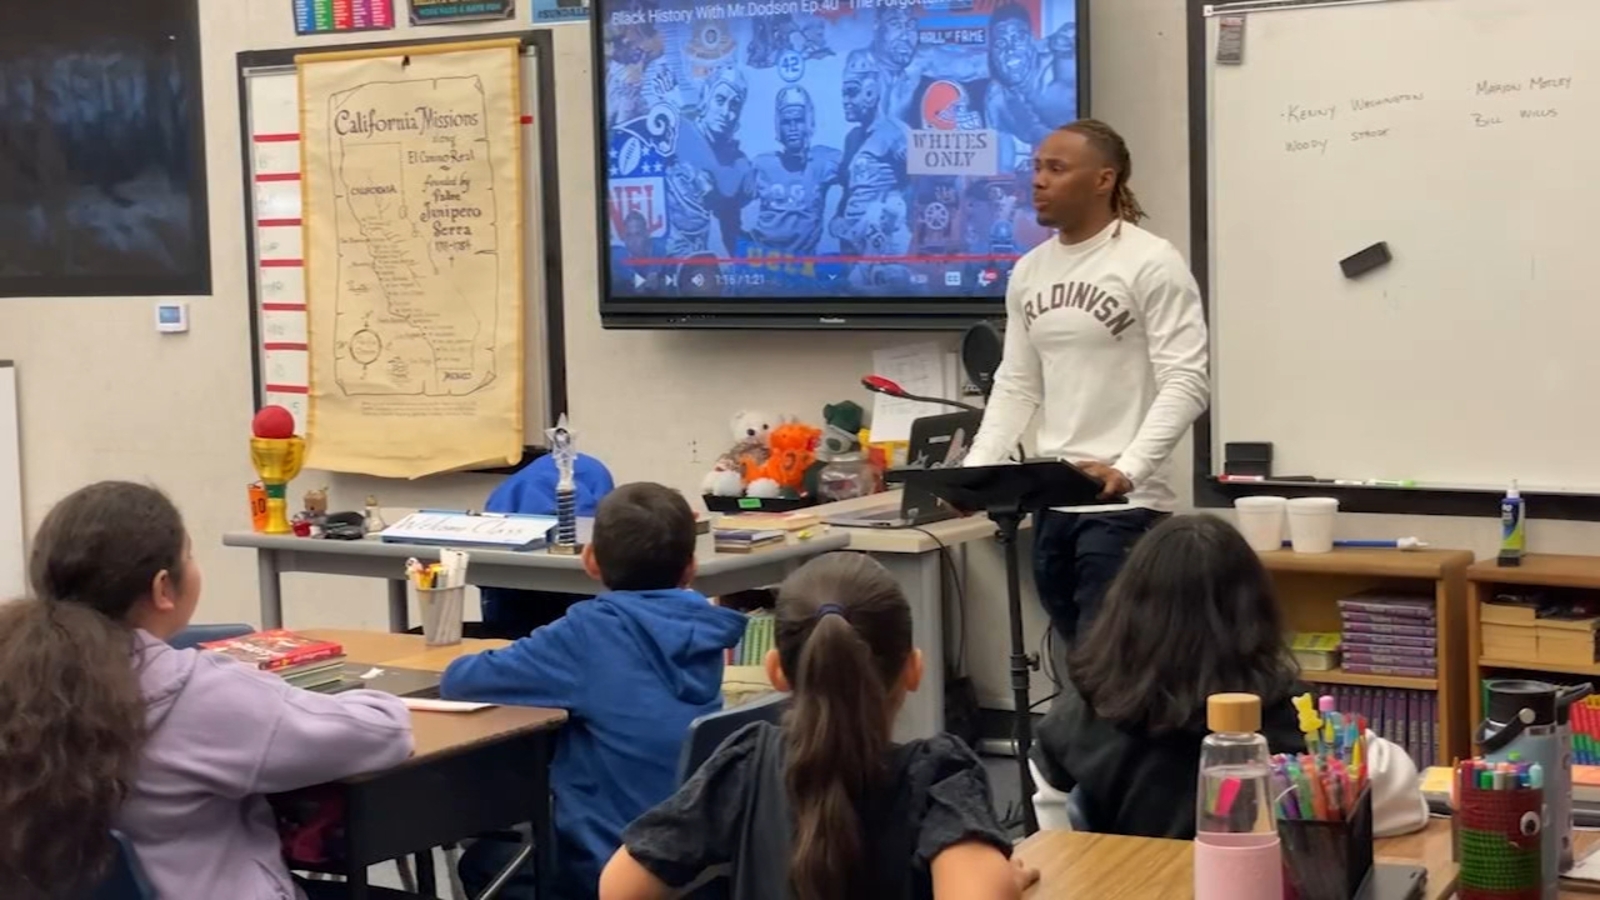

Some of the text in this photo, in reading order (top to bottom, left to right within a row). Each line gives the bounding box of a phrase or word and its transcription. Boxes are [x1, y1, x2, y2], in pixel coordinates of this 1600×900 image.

[611, 10, 646, 26] Black
[649, 8, 693, 24] History
[695, 5, 725, 20] With
[919, 30, 945, 44] HALL
[954, 29, 985, 43] FAME
[780, 57, 800, 73] 42
[334, 106, 479, 139] California Missions
[1470, 112, 1503, 128] BILL
[912, 132, 988, 150] WHITES
[407, 150, 418, 165] El
[449, 148, 476, 164] Real
[924, 150, 976, 168] ONLY
[460, 170, 471, 194] by
[432, 187, 462, 202] Padre
[419, 201, 482, 223] Junipero
[608, 184, 663, 242] NFL
[432, 220, 473, 238] Serra
